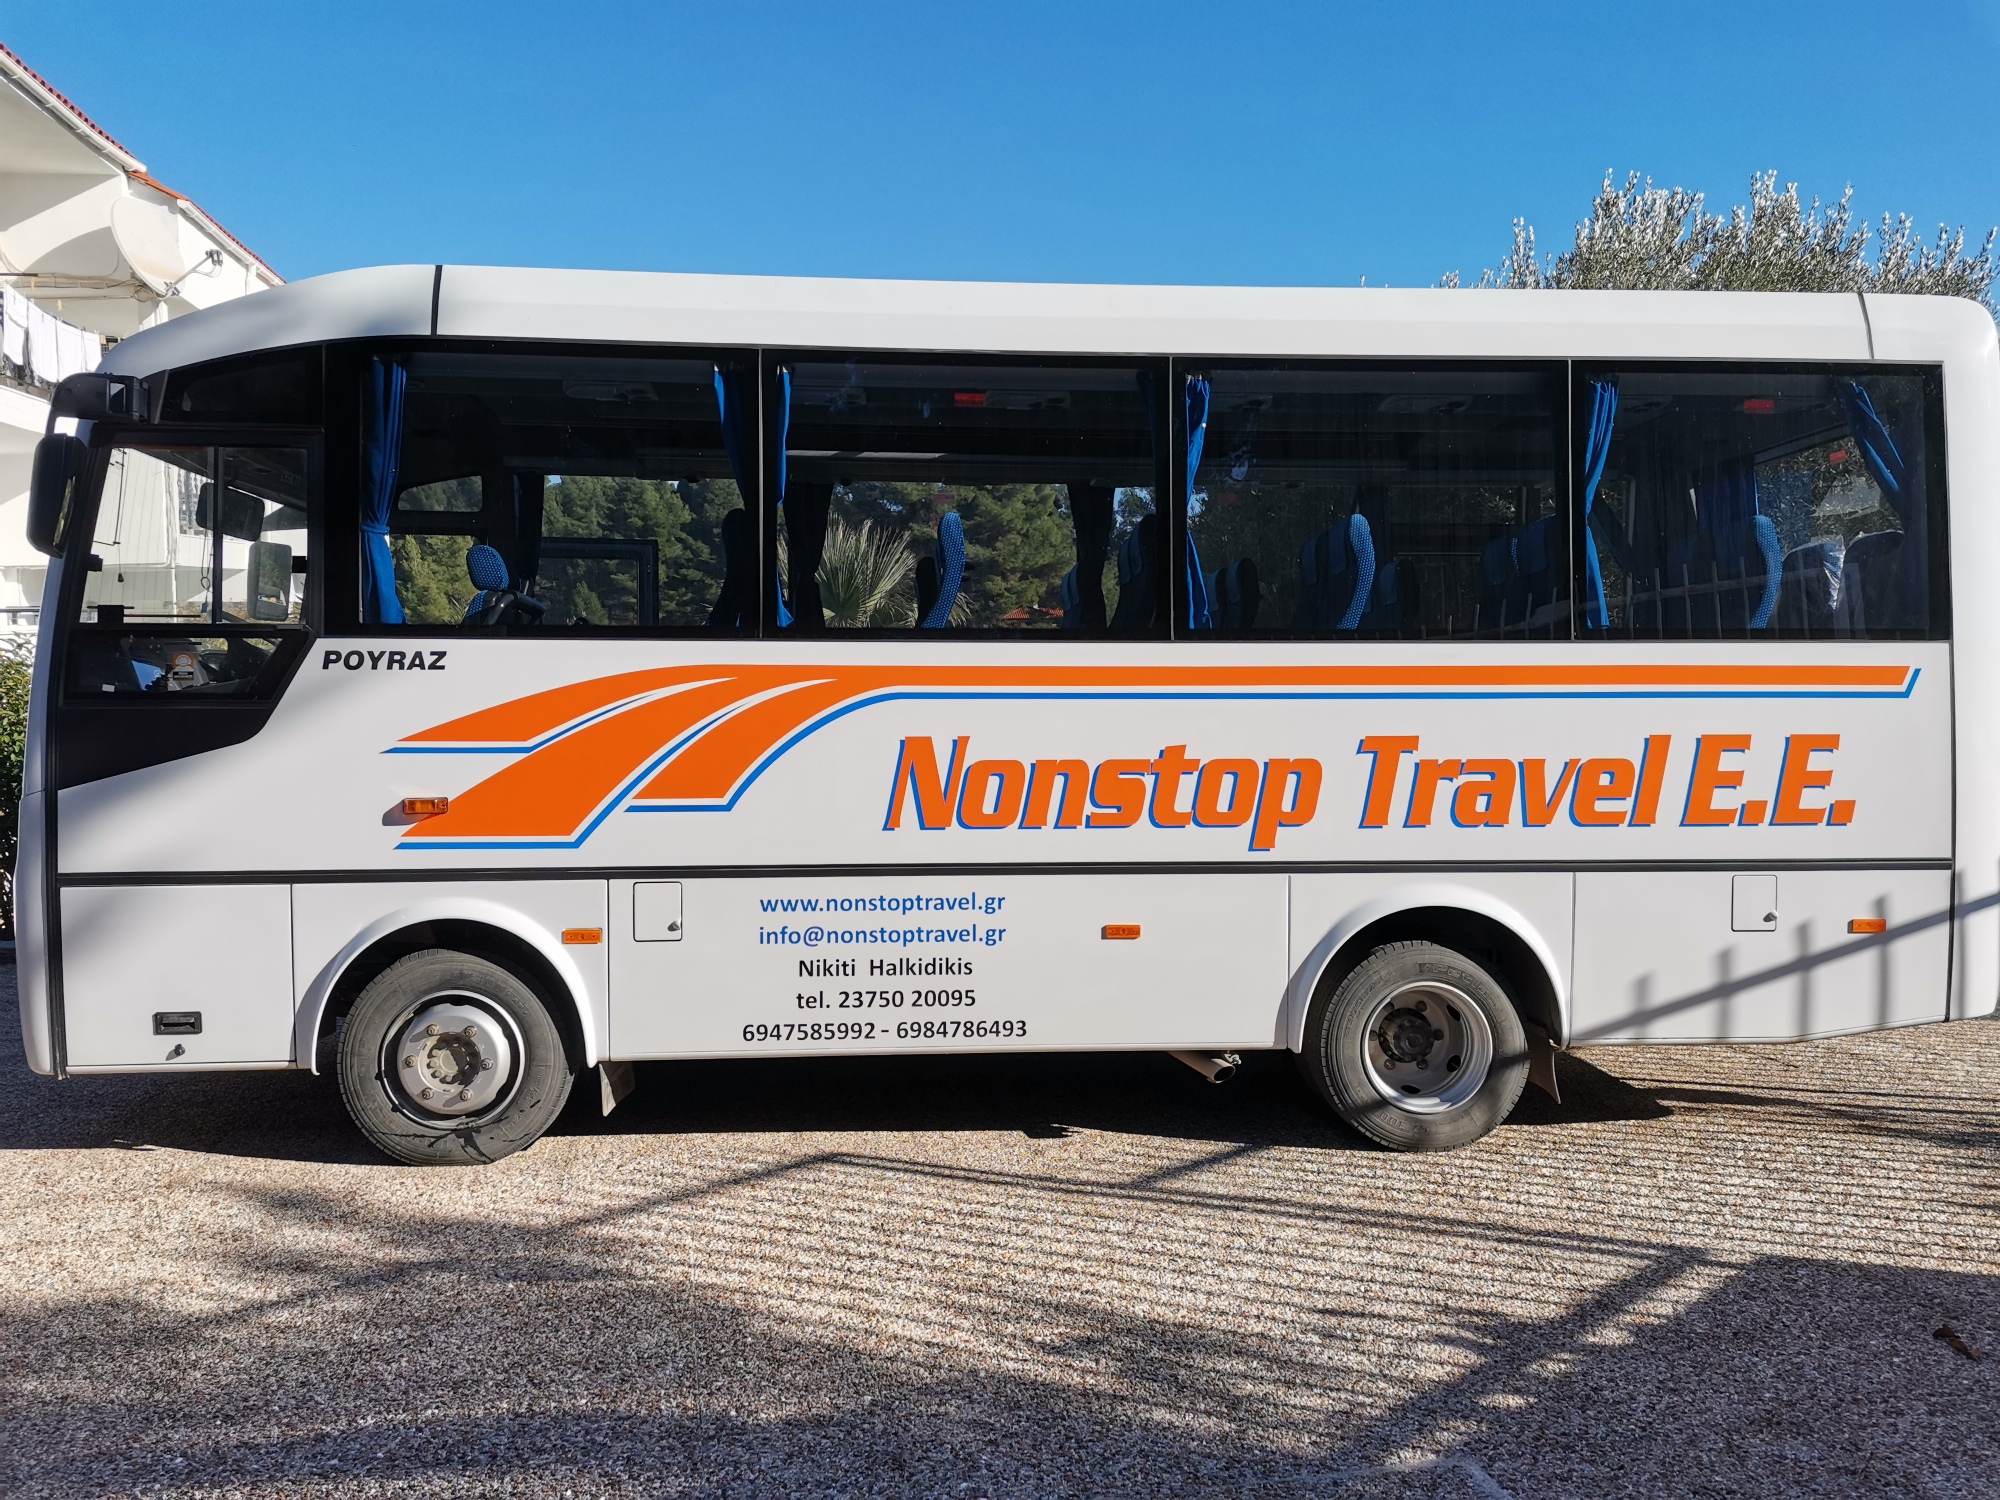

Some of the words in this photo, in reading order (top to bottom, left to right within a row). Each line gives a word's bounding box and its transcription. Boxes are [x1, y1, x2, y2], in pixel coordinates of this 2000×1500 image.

[321, 649, 448, 671] POYRAZ
[882, 735, 1324, 853] Nonstop
[1356, 733, 1673, 829] Travel
[1678, 733, 1858, 828] E.E.
[759, 891, 1006, 916] www.nonstoptravel.gr
[758, 923, 1007, 948] info@nonstoptravel.gr
[798, 958, 856, 978] Nikiti
[868, 956, 974, 977] Halkidikis
[795, 990, 831, 1009] tel.
[838, 990, 904, 1009] 23750
[910, 989, 976, 1007] 20095
[742, 1022, 876, 1042] 6947585992
[895, 1019, 1028, 1040] 6984786493
